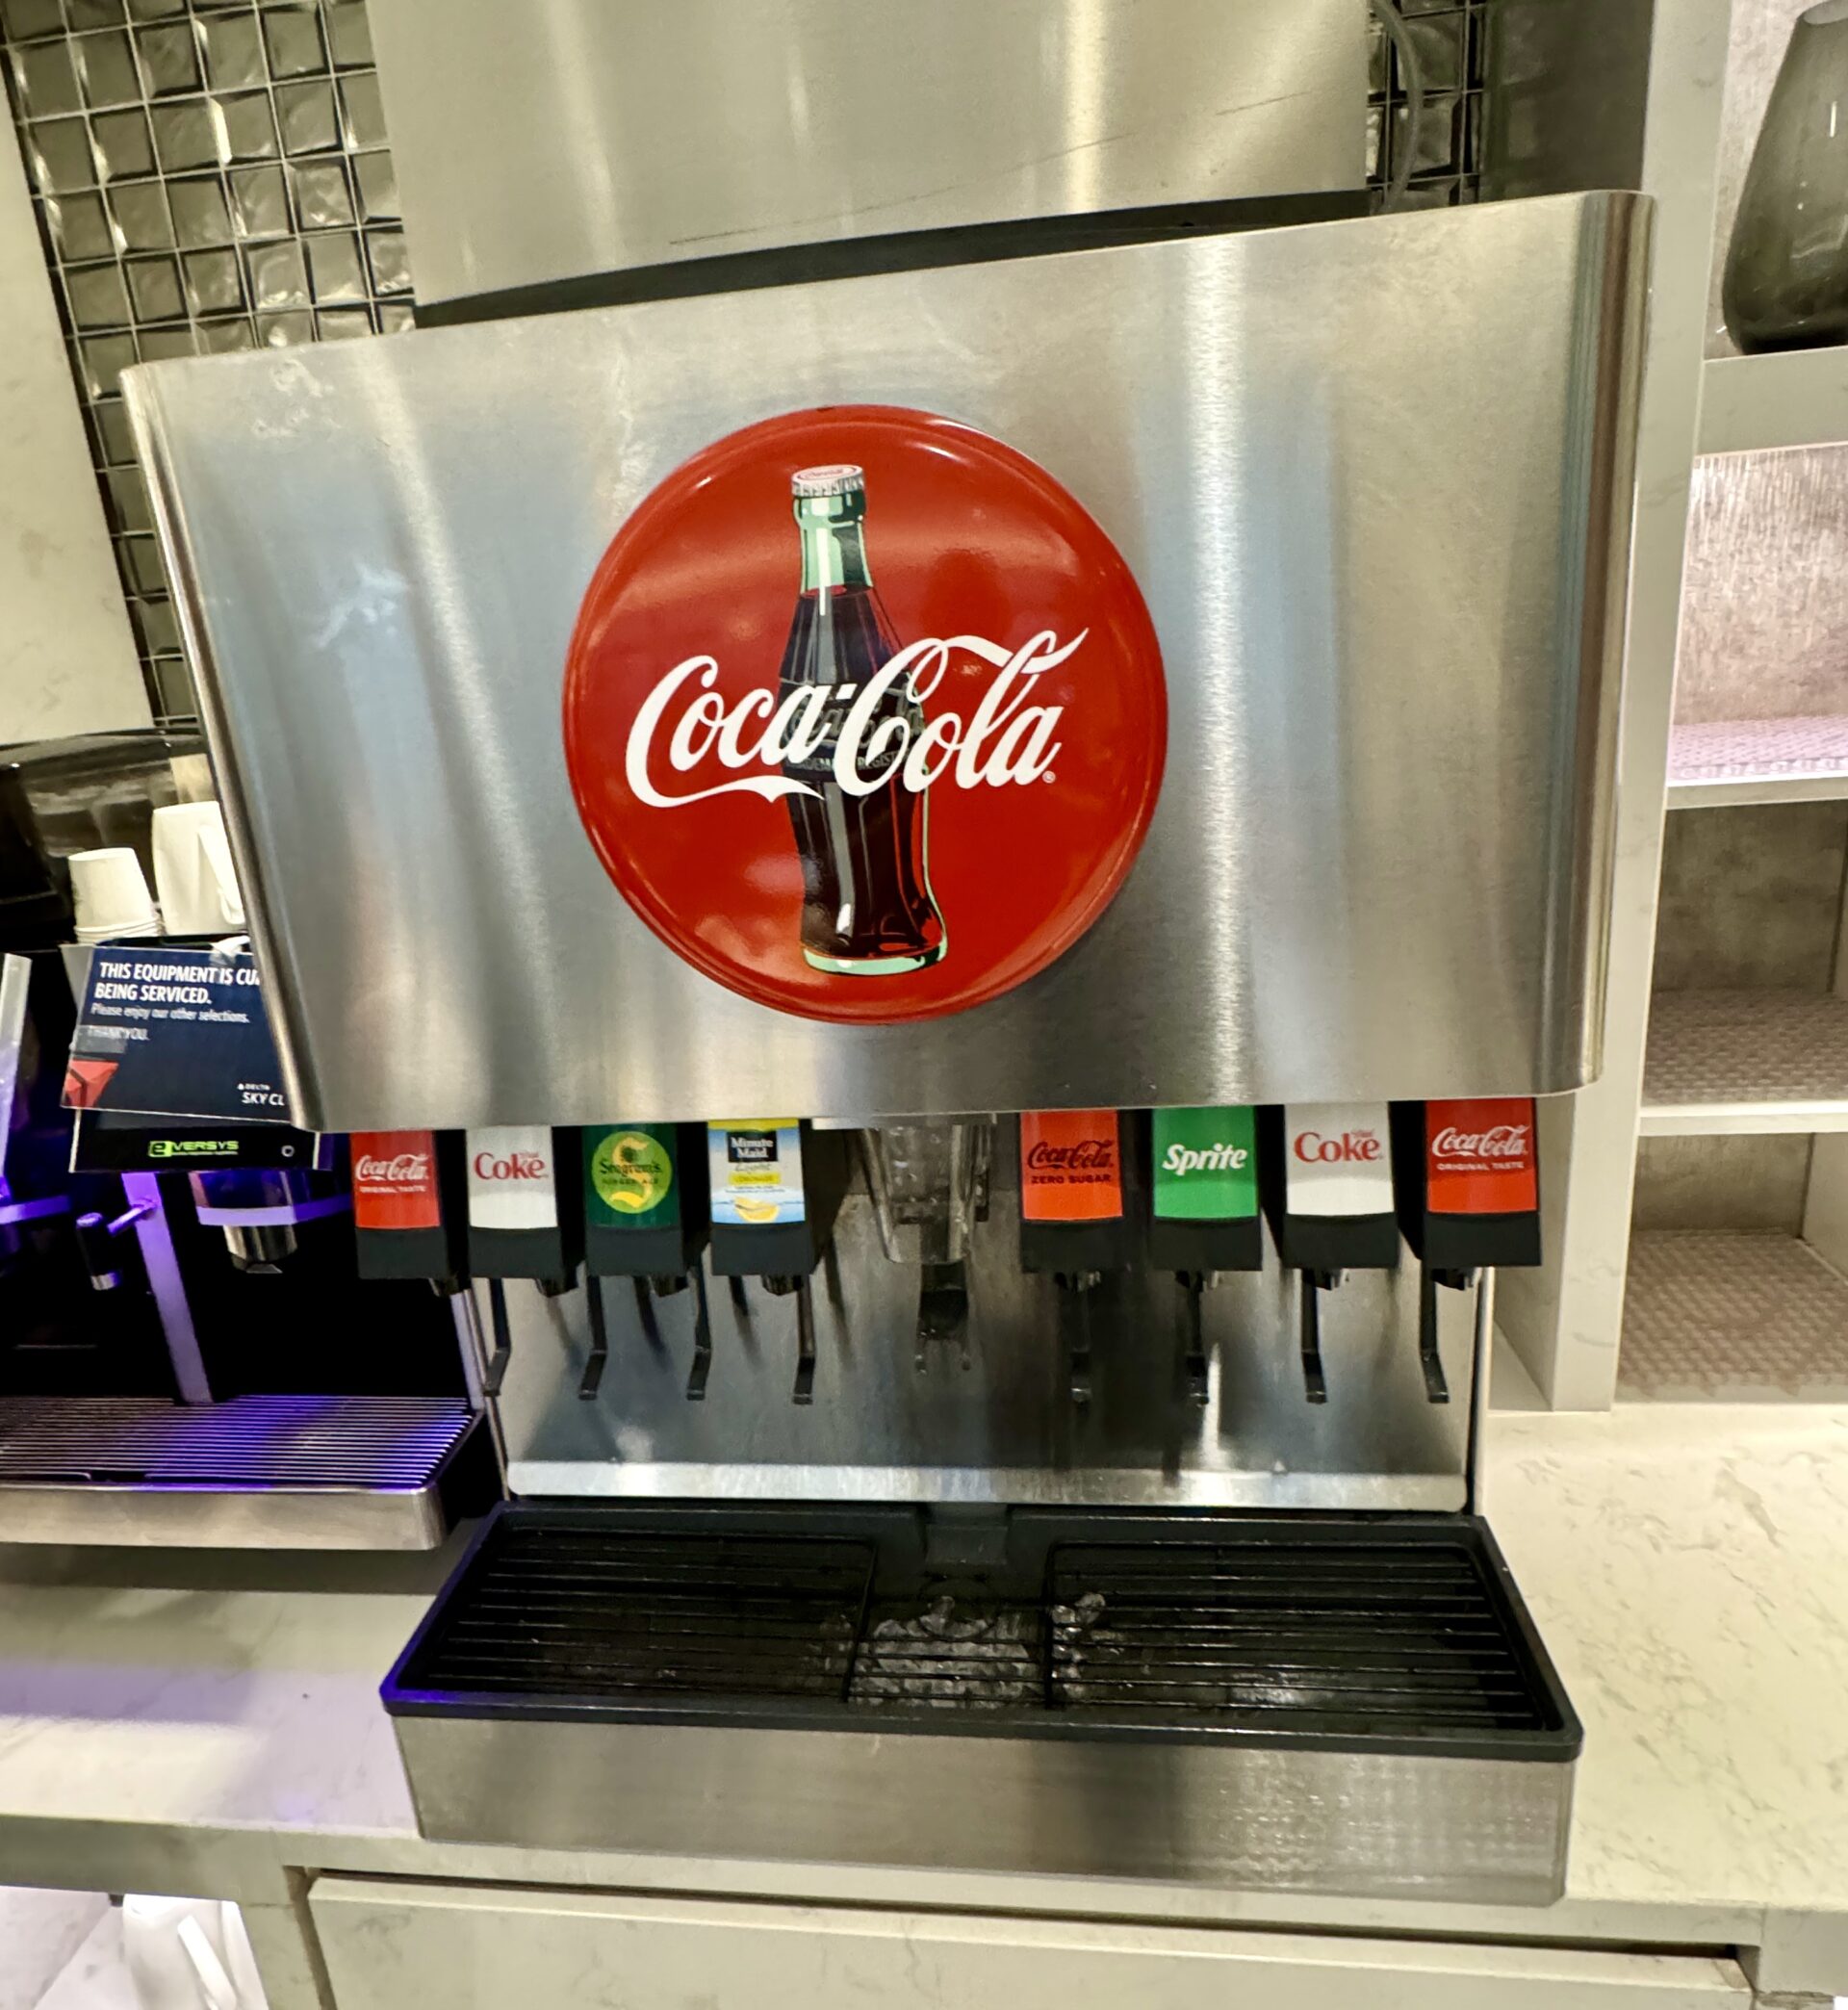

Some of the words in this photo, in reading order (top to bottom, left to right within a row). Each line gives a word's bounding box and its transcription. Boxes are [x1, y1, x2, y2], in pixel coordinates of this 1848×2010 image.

[626, 628, 1089, 808] Coca-Cola
[100, 963, 131, 979] THIS
[134, 964, 218, 983] EQUIPMENT
[219, 967, 233, 985] IS
[236, 967, 260, 986] CU
[94, 983, 138, 999] BEING
[140, 986, 212, 1004] SERVICED.
[90, 1002, 122, 1016] Please
[123, 1006, 150, 1019] enjoy
[151, 1009, 168, 1018] our
[169, 1008, 197, 1019] other
[198, 1009, 250, 1023] selections.
[242, 1092, 268, 1104] SKY
[269, 1094, 285, 1106] CL
[731, 1137, 774, 1148] Minute
[1294, 1131, 1380, 1163] Coke
[1431, 1124, 1530, 1158] Coca-Cola
[355, 1153, 428, 1181] Coca-Cola
[474, 1151, 546, 1180] Coke
[1028, 1140, 1114, 1170] Coca-Cola
[1162, 1143, 1248, 1176] Sprite
[1491, 1161, 1525, 1170] TASTE
[1031, 1174, 1065, 1185] ZERO
[1068, 1173, 1112, 1185] SUGAR
